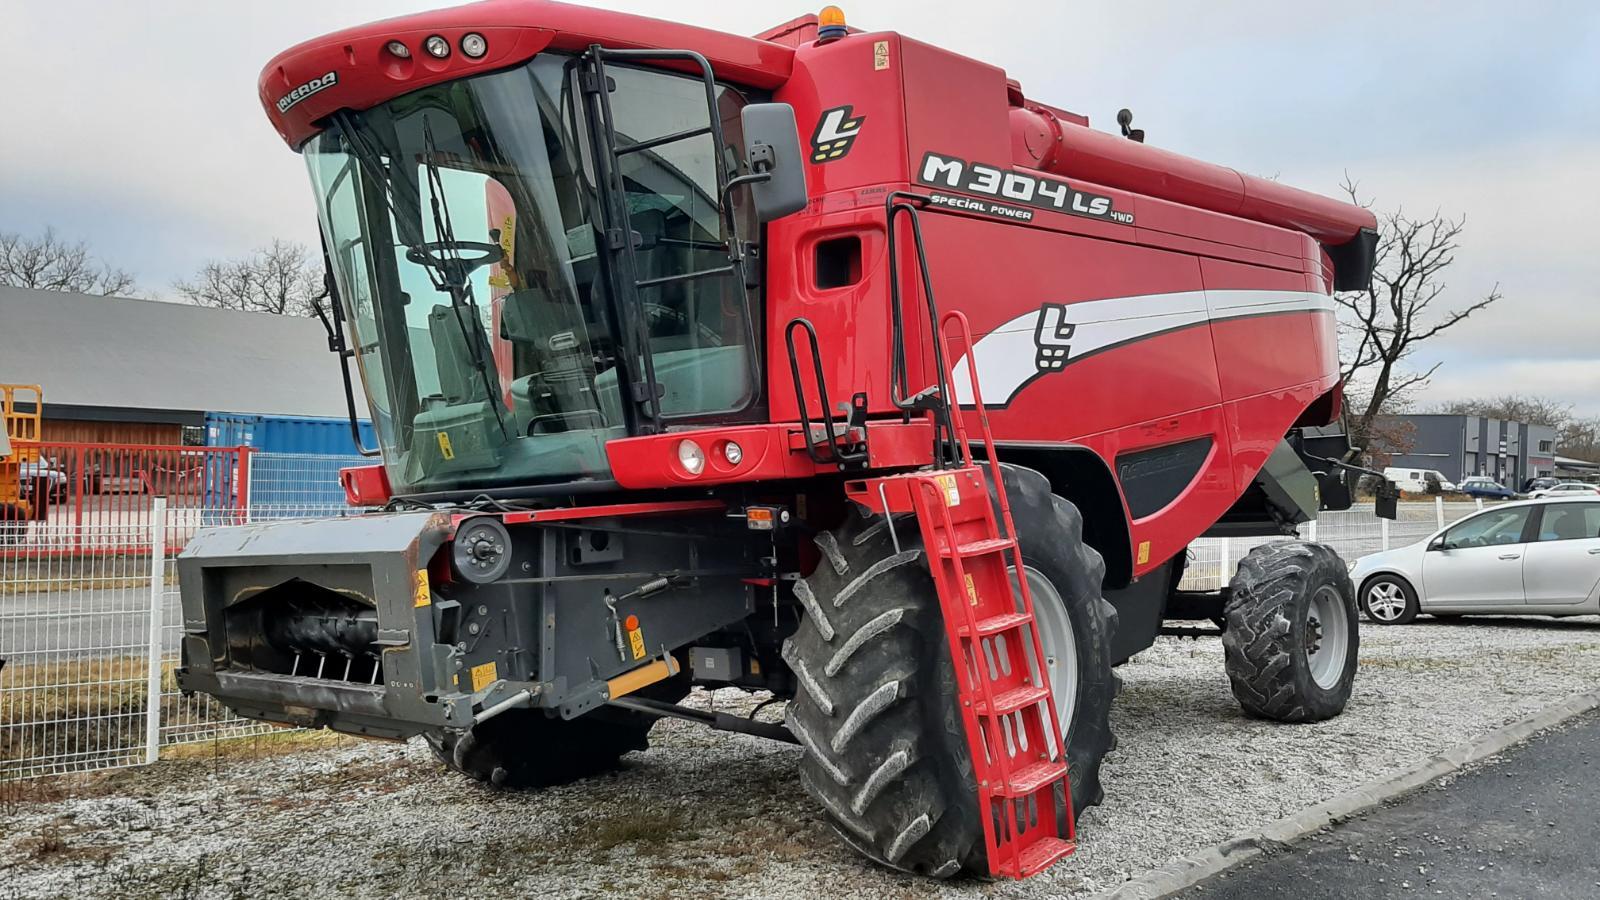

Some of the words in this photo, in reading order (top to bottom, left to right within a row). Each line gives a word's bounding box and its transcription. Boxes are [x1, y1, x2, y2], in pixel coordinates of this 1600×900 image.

[276, 72, 337, 113] LAVERDA
[923, 155, 963, 187] M
[968, 166, 1067, 208] 304
[1072, 193, 1110, 215] LS
[1110, 211, 1134, 223] 4WD
[990, 205, 1032, 220] POWER
